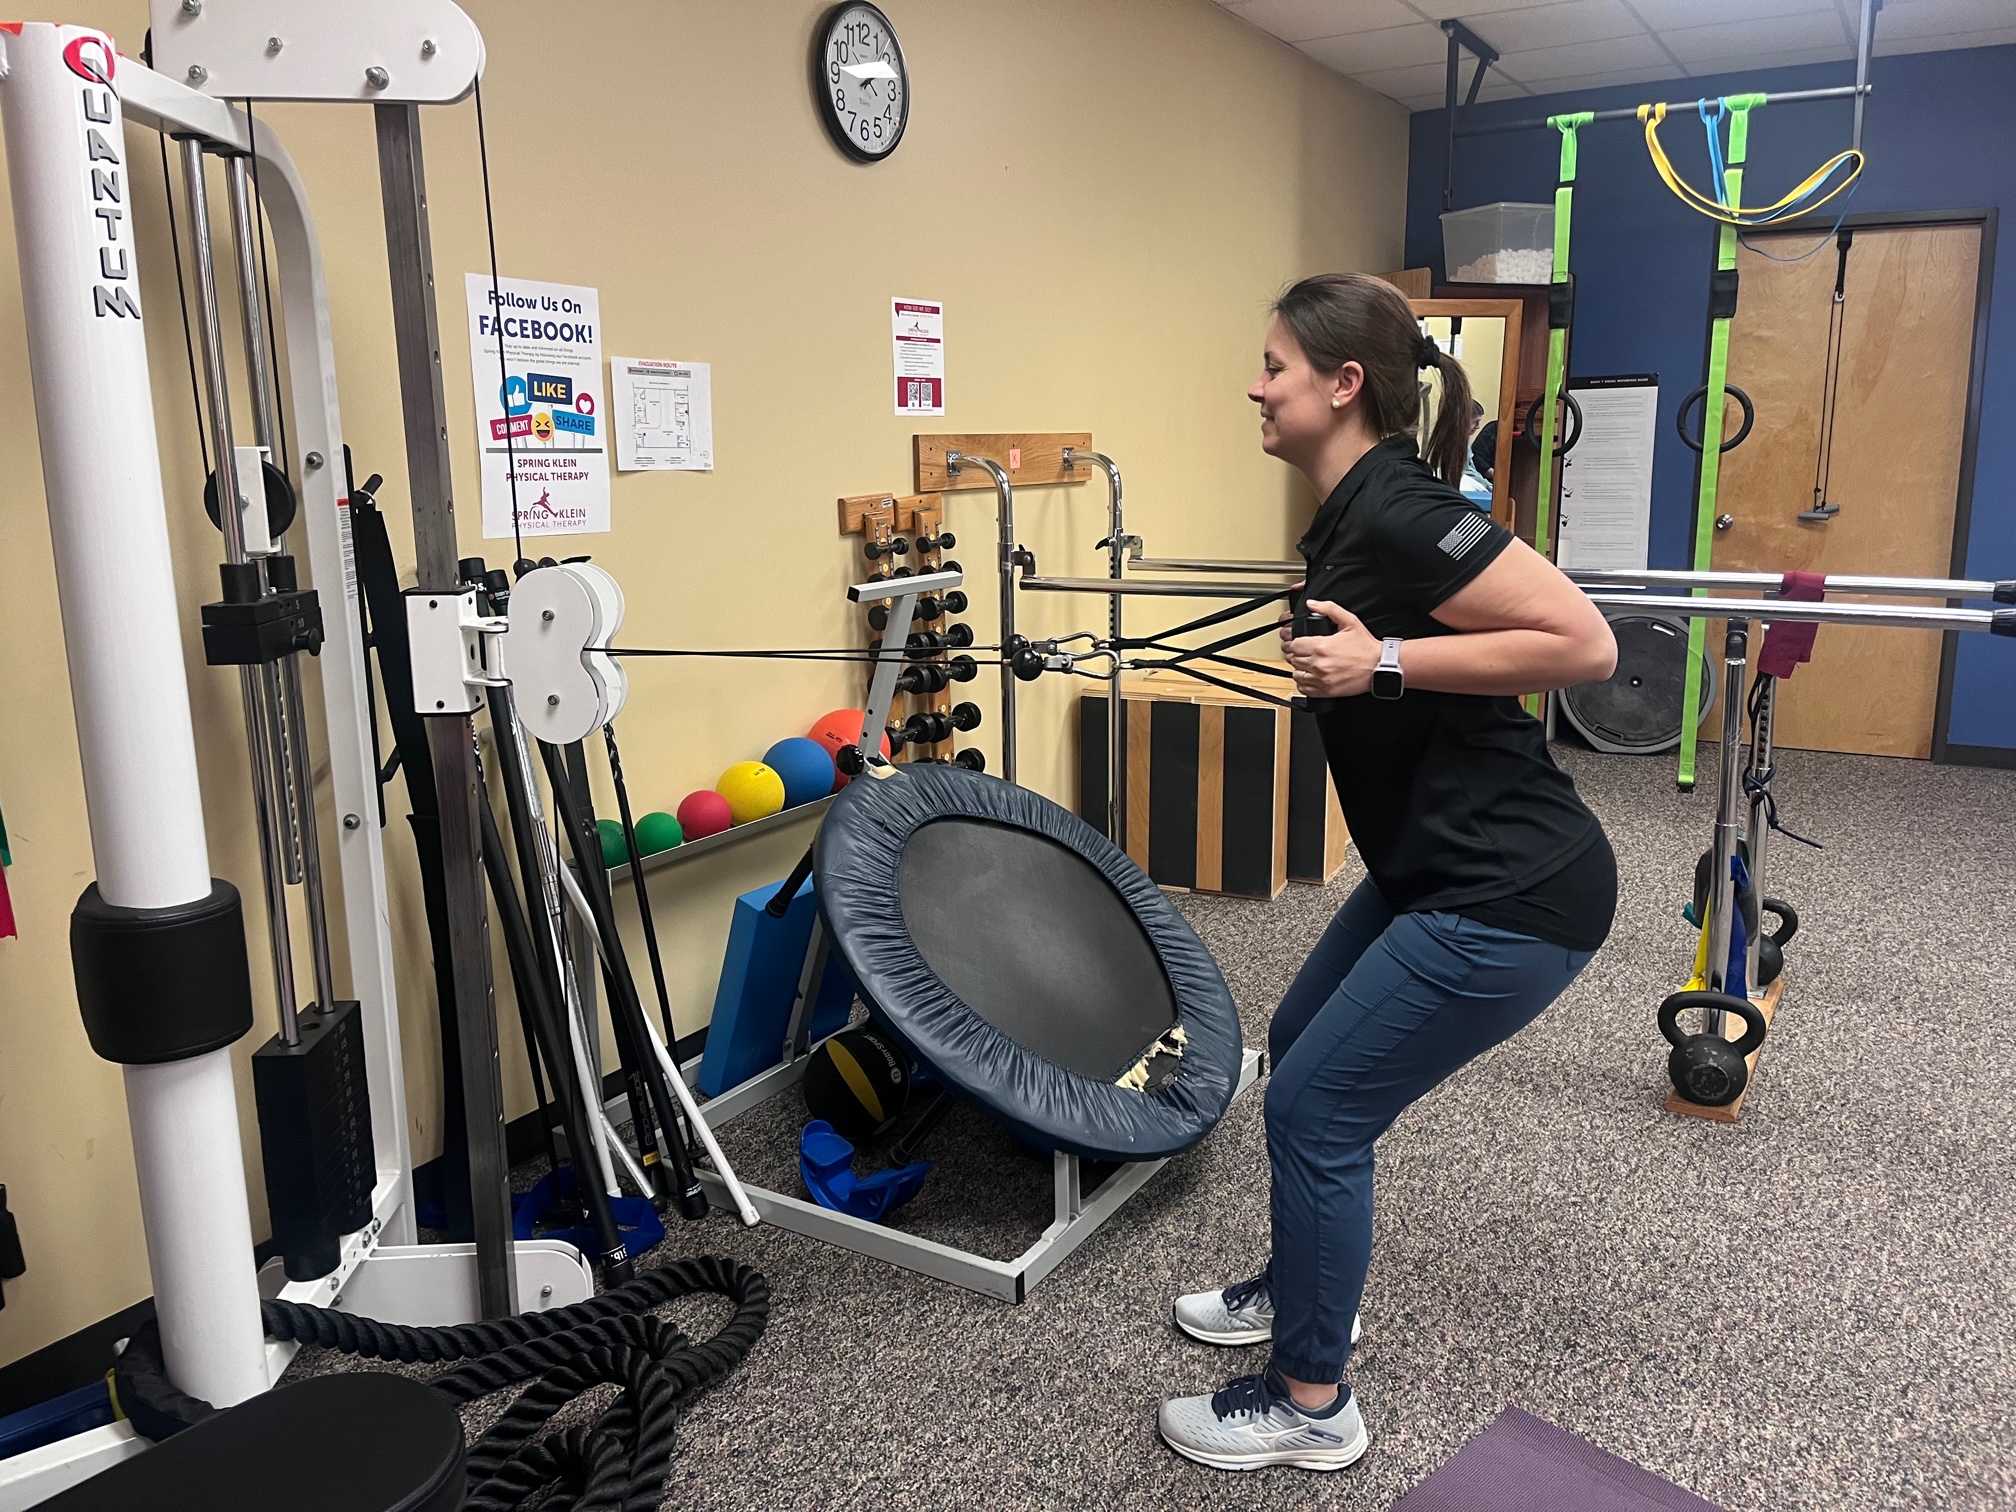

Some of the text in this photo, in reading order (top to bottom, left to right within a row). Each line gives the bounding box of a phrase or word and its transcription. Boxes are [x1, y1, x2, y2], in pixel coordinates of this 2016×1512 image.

[844, 23, 855, 47] 11
[856, 21, 870, 47] 12
[873, 33, 879, 55] 1
[834, 39, 849, 64] 10
[830, 61, 841, 84] 9
[836, 88, 846, 111] 8
[887, 80, 896, 102] 3
[847, 110, 857, 132] 7
[883, 104, 892, 125] 4
[860, 119, 870, 141] 6
[873, 116, 882, 138] 5
[63, 36, 141, 320] QUANTUM
[488, 290, 582, 314] Follow Us On
[479, 315, 593, 344] FACEBOOK!
[533, 380, 567, 399] LIKE
[555, 415, 591, 431] SHARE
[517, 458, 577, 468] SPRING KLEIN
[505, 471, 589, 482] PHYSICAL THERAPY
[511, 506, 586, 521] SPRING KLEIN
[511, 519, 586, 530] PHYSICAL THERAPY
